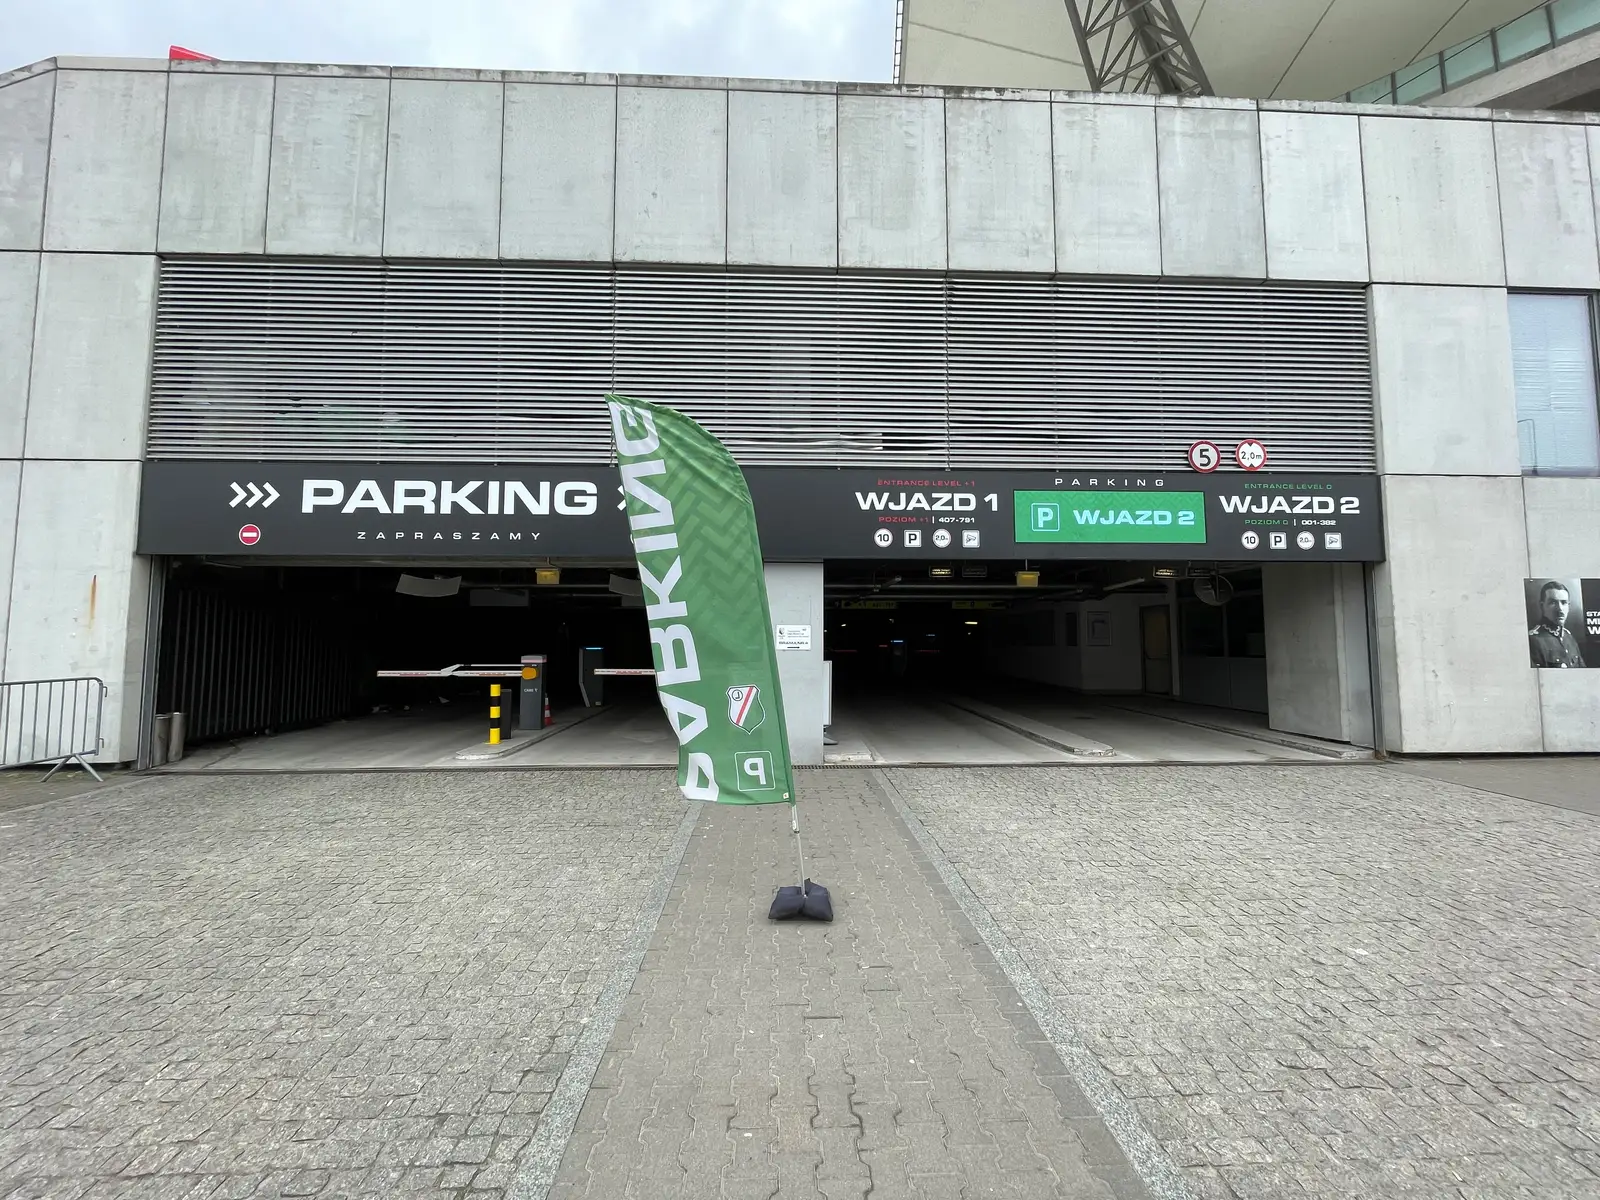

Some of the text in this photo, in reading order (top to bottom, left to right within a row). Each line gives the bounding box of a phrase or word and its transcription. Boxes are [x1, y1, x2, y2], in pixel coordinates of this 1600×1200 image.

[1199, 448, 1212, 467] 5
[1054, 478, 1164, 487] PARKING
[301, 479, 598, 516] PARKING
[855, 491, 998, 512] WJAZD 1
[1218, 495, 1360, 514] WJAZD 2
[1037, 507, 1195, 528] P WJAZD 2
[357, 531, 541, 540] ZAPRASZAMY
[877, 533, 890, 542] 10
[908, 533, 918, 544] P
[1244, 536, 1256, 544] 10
[1273, 535, 1283, 546] P
